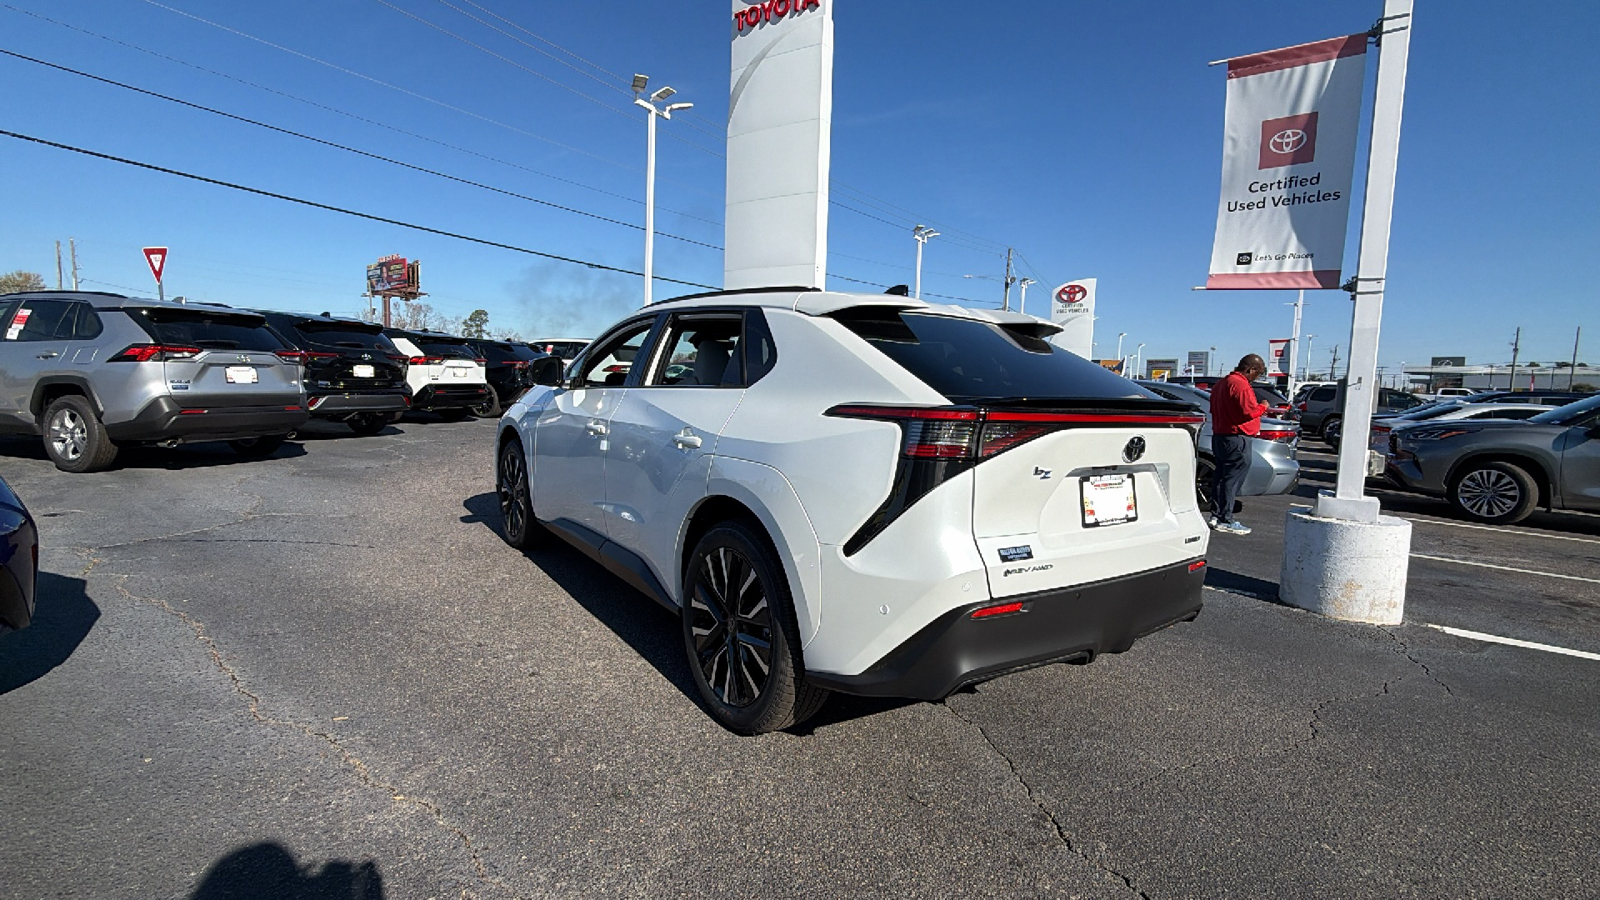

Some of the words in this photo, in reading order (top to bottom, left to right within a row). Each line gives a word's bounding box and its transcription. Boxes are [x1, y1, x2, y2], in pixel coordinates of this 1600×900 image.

[1248, 172, 1321, 193] Certified
[1227, 196, 1267, 212] Used
[1271, 190, 1341, 208] Vehicles
[1274, 252, 1287, 261] Go
[1288, 252, 1314, 260] Places
